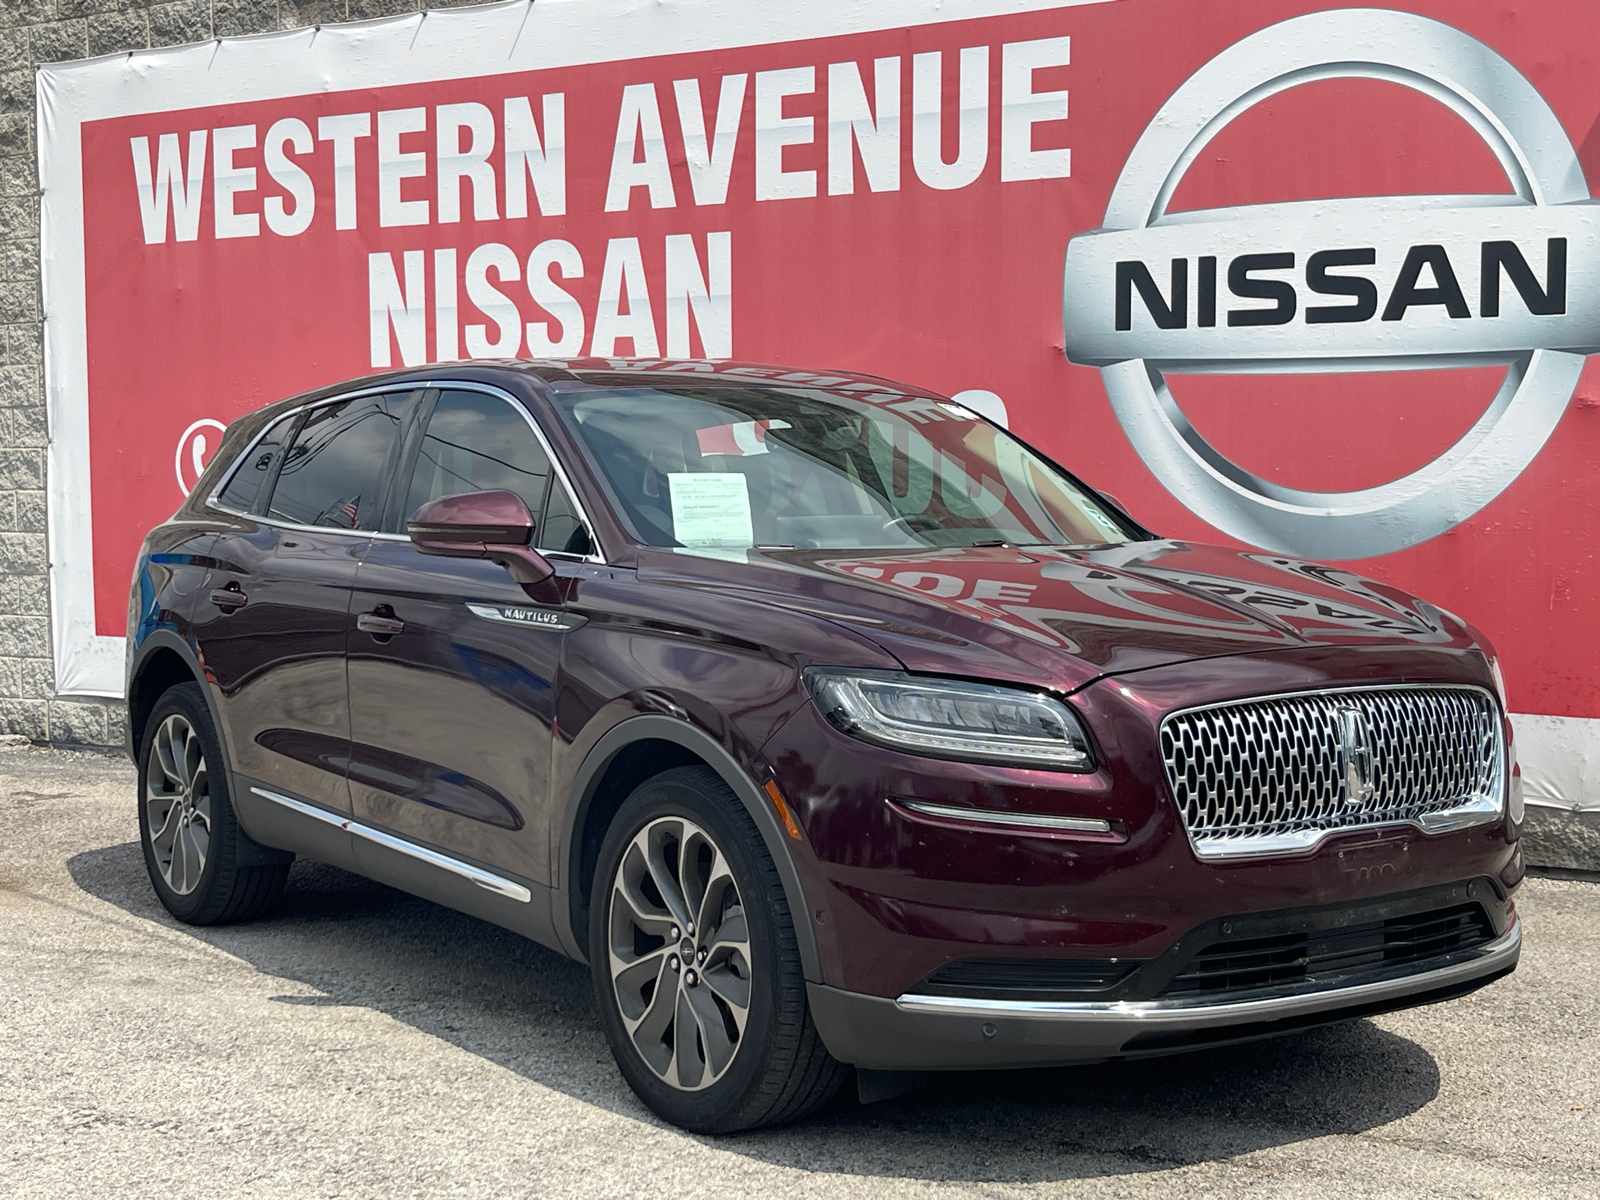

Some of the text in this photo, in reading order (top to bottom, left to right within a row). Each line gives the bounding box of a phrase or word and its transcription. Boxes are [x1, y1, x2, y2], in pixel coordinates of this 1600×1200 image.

[131, 36, 1072, 245] WESTERN AVENUE
[369, 232, 733, 367] NISSAN
[1115, 238, 1567, 331] NISSAN
[504, 608, 558, 623] NAUTILUS
